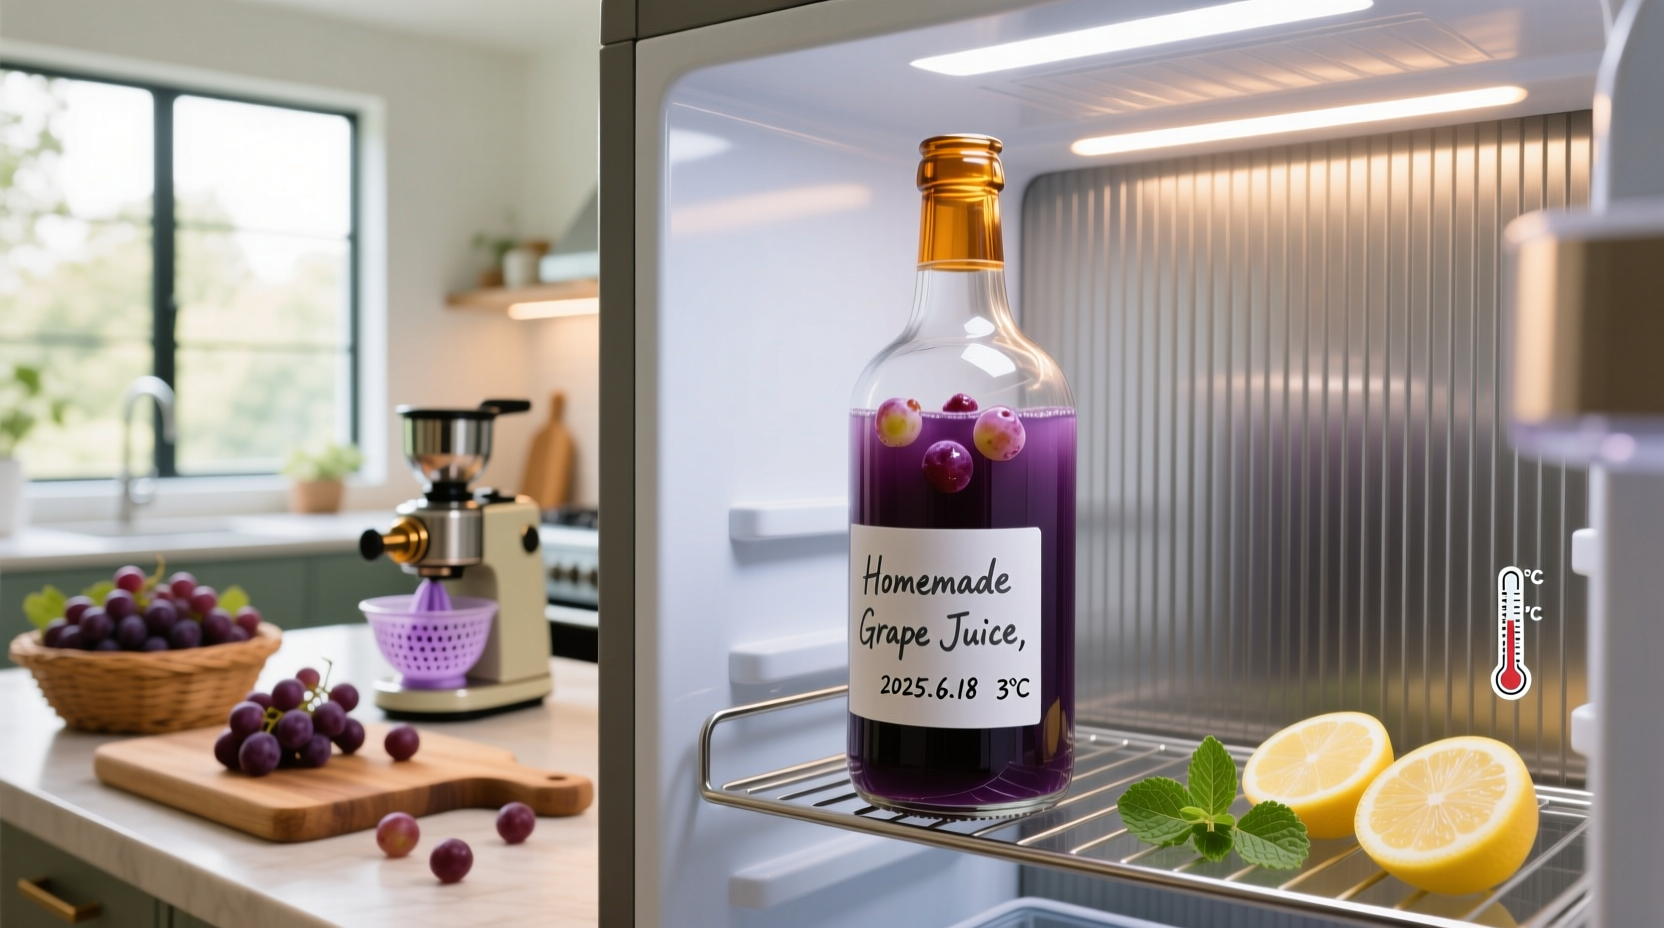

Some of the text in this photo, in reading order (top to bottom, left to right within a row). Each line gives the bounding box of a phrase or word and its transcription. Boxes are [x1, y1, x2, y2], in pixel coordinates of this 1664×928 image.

[863, 554, 1012, 595] Homemade
[859, 607, 1025, 661] Grape Juice,
[880, 674, 1030, 700] 2025.6.18 3°C
